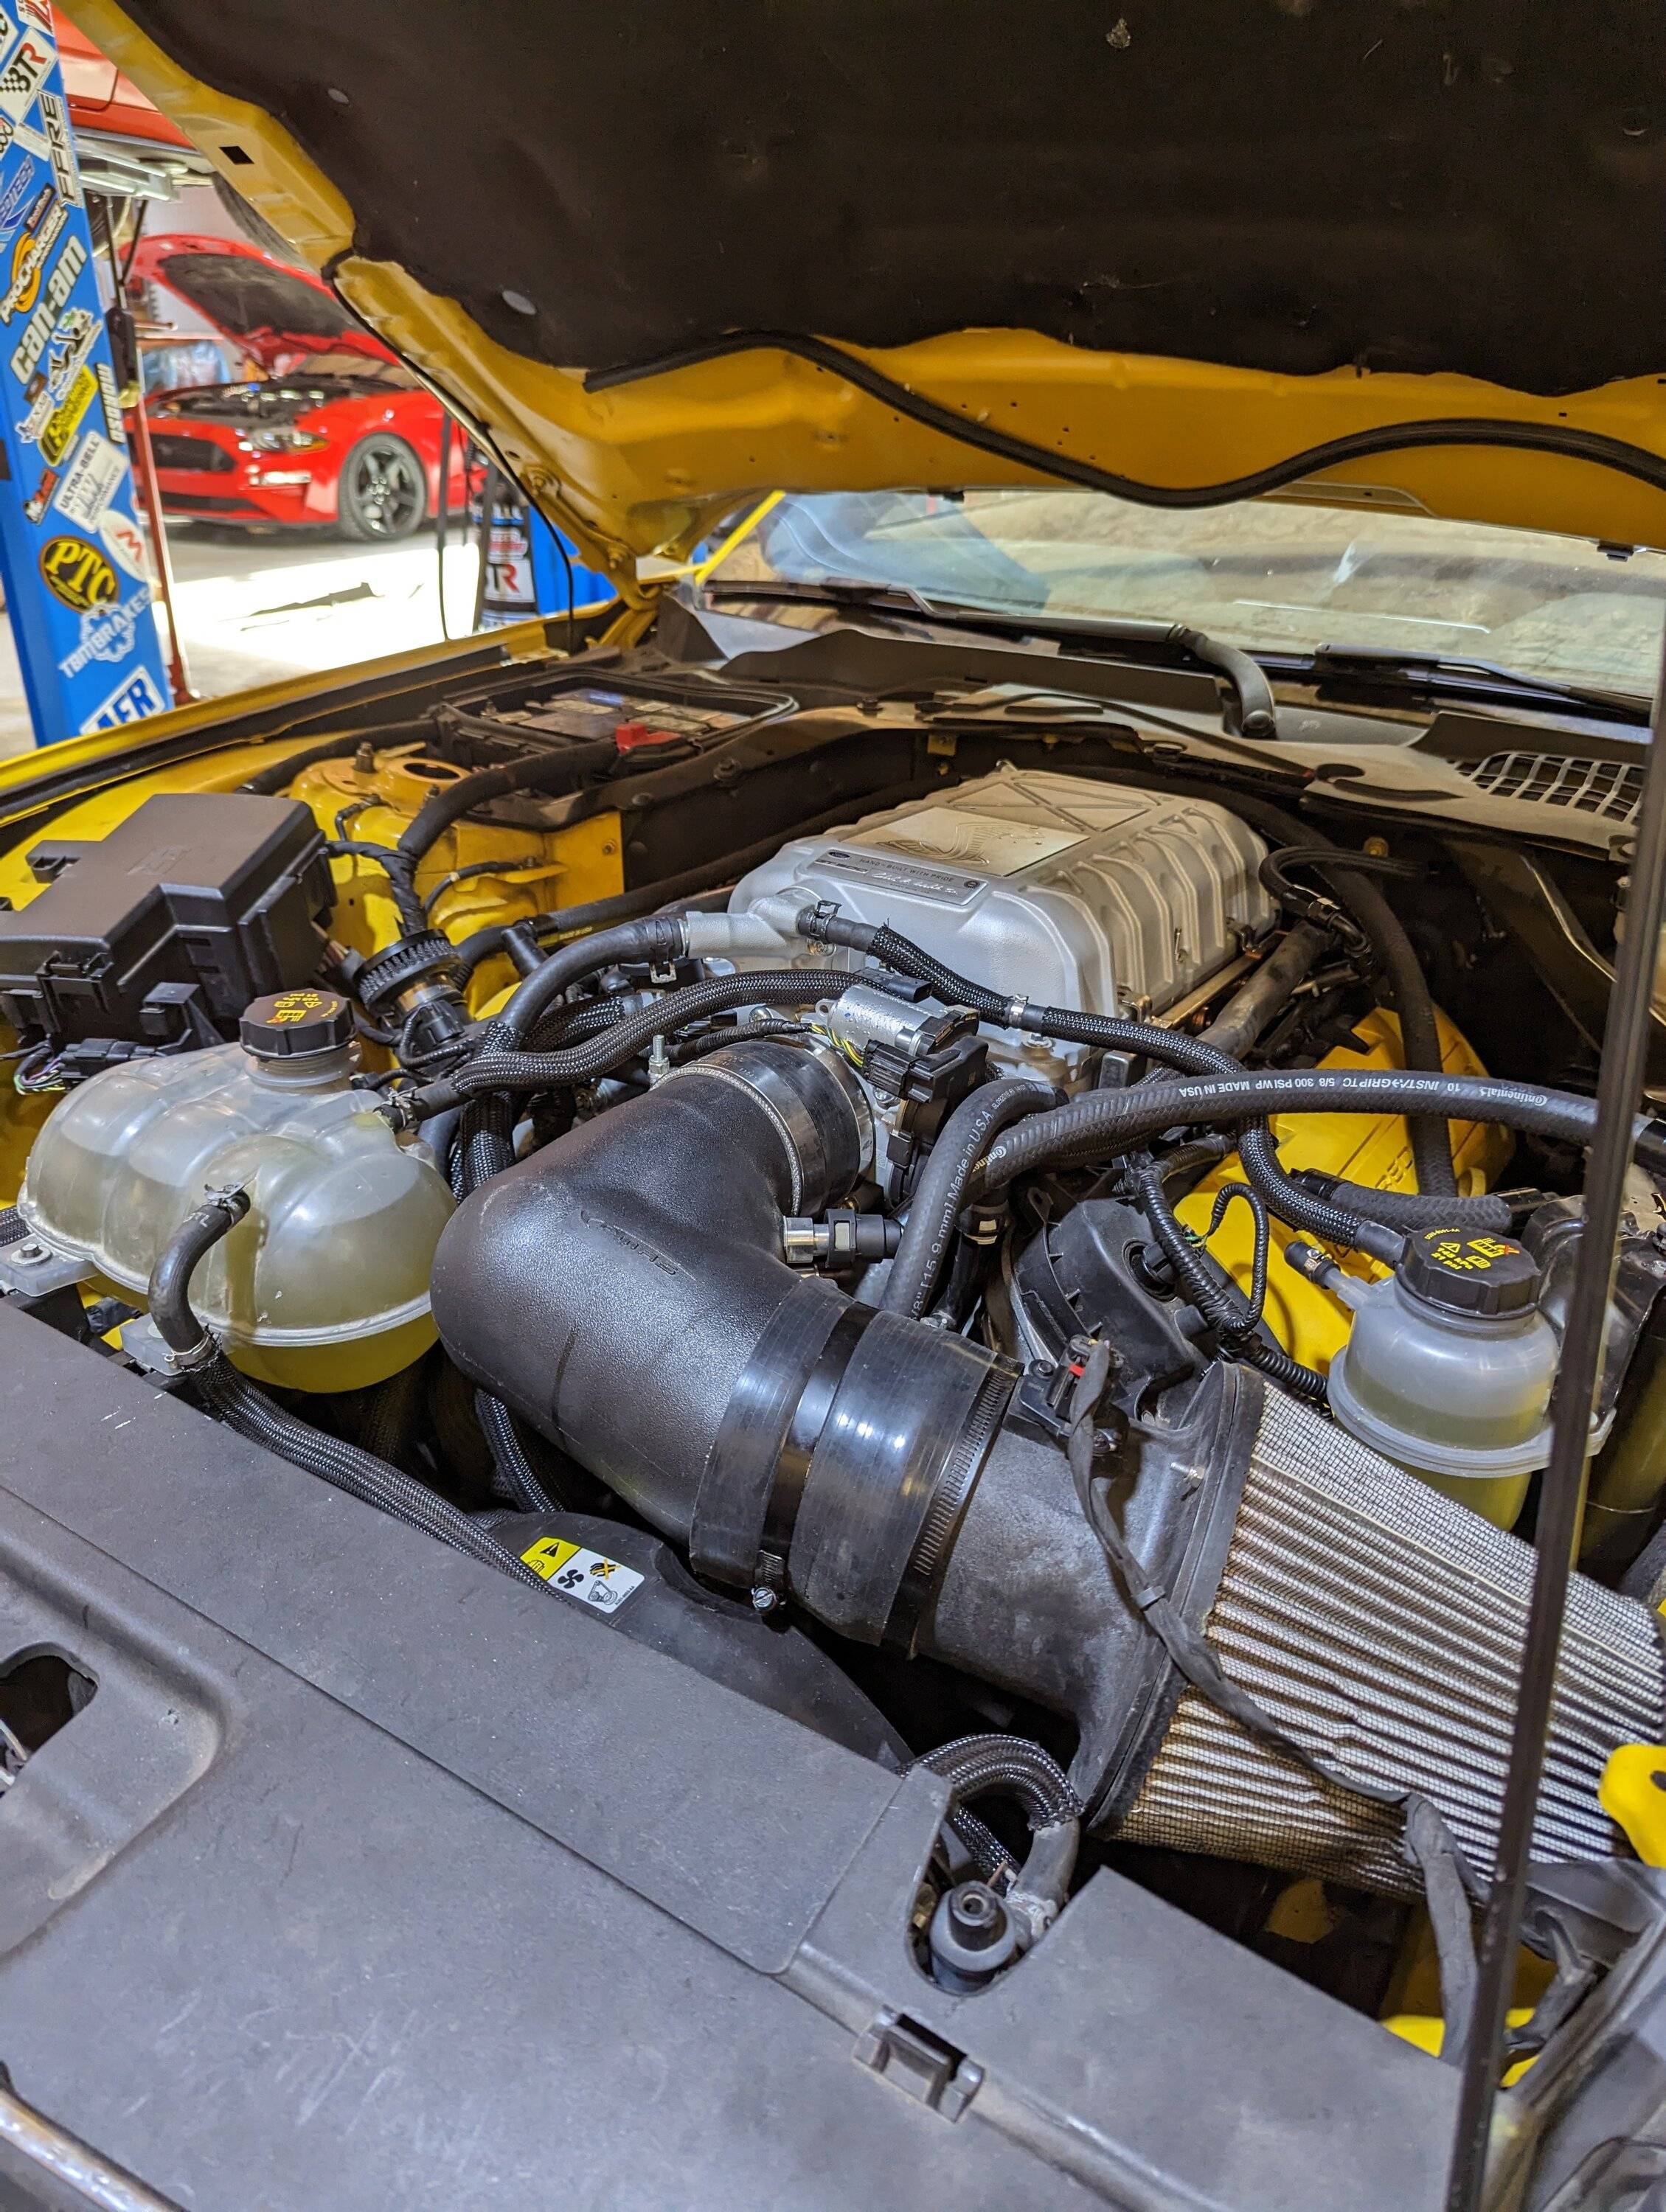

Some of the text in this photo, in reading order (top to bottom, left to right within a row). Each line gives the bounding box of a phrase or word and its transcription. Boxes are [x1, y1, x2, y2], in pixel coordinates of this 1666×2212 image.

[0, 42, 47, 94] BTR
[10, 235, 88, 384] can-am
[45, 541, 116, 605] PTC
[931, 872, 954, 883] PRIDE
[1218, 1080, 1250, 1093] MADE
[1255, 1079, 1274, 1090] WP
[1274, 1078, 1292, 1088] PSI
[1294, 1078, 1314, 1088] 300
[1318, 1077, 1335, 1088] 5/8
[1342, 1077, 1358, 1088] TC
[1447, 1082, 1460, 1092] 10
[1179, 1086, 1203, 1098] USA
[1204, 1084, 1216, 1095] IN
[1487, 1086, 1548, 1106] Continental
[947, 1158, 969, 1200] Made
[962, 1143, 976, 1158] in
